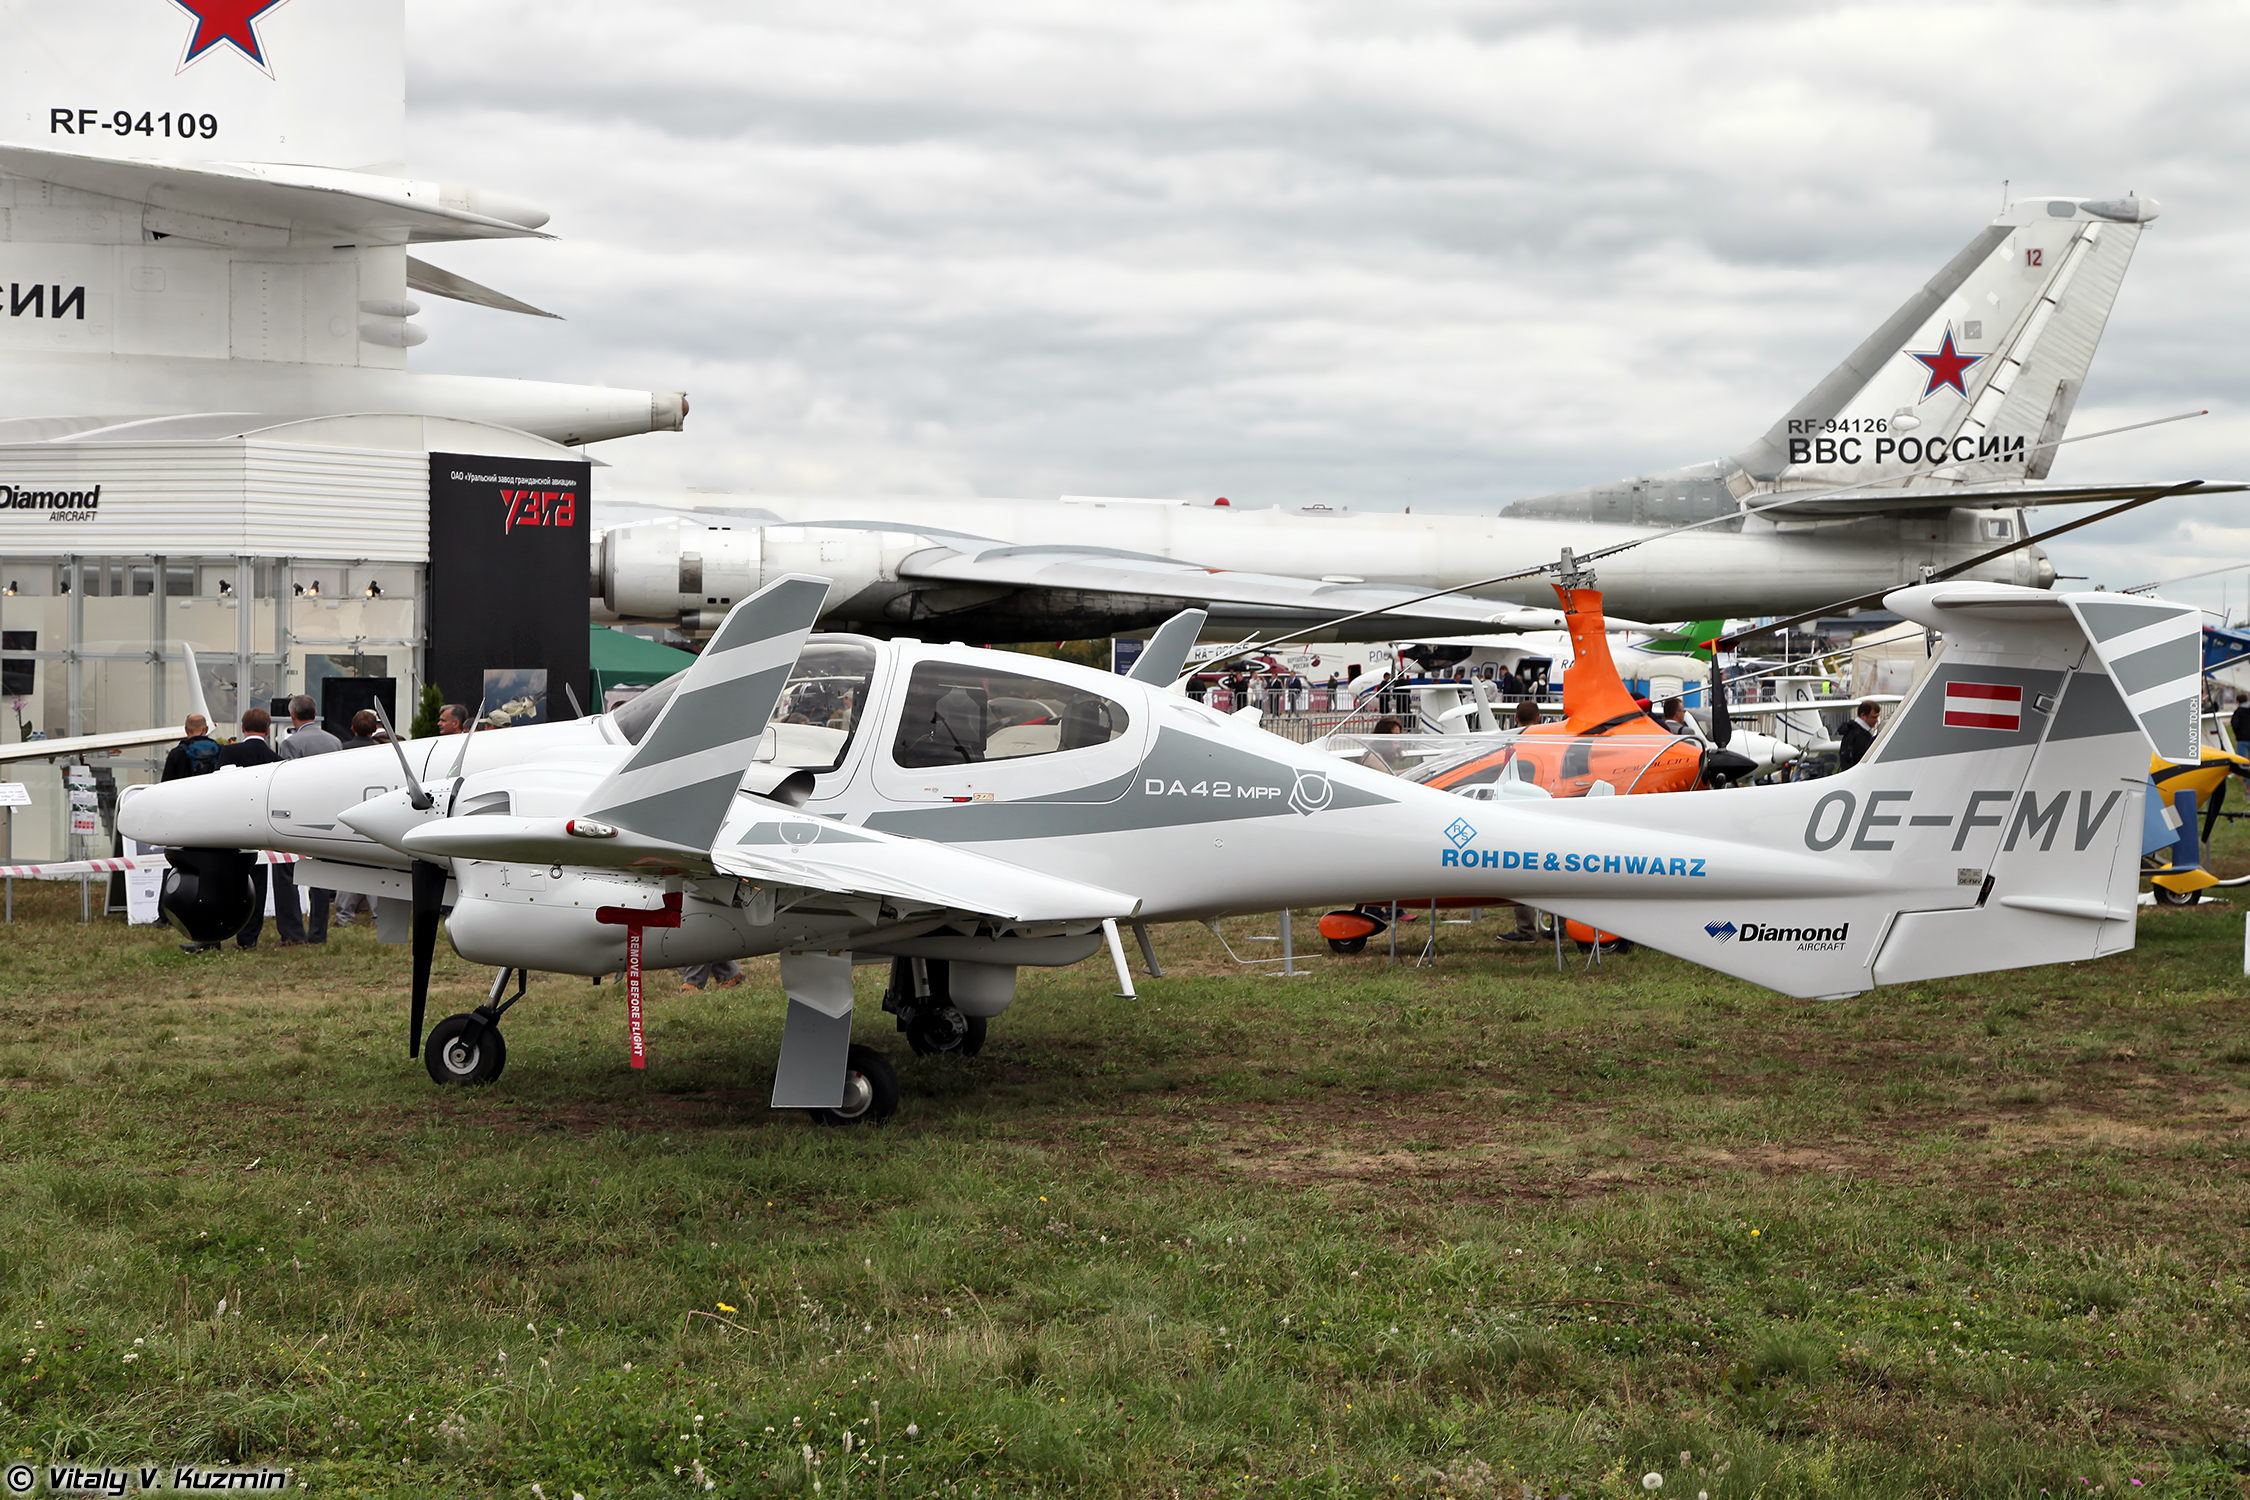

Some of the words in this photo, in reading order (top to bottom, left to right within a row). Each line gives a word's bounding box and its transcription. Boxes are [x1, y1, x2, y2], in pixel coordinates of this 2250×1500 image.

[50, 107, 218, 139] RF-94109
[2026, 249, 2042, 267] 12
[0, 282, 85, 320] ИИ
[1788, 418, 1888, 434] RF-94126
[1789, 437, 1862, 464] ВВС
[1875, 435, 2025, 464] РОССИИ
[49, 511, 97, 521] AIRCRAFT
[2189, 698, 2198, 725] TOUCH
[2188, 726, 2198, 744] NOT
[2188, 744, 2198, 757] DO
[1145, 778, 1232, 798] DA42
[1237, 786, 1281, 799] MPP
[1804, 789, 2123, 852] OE-FMV
[1441, 848, 1707, 877] ROHDE&SCHWARZ
[1738, 922, 1849, 942] Diamond
[630, 936, 640, 977] REMOVE
[1796, 943, 1846, 951] AIRCRAFT
[630, 980, 640, 1018] BEFORE
[631, 1021, 643, 1056] FLIGHT
